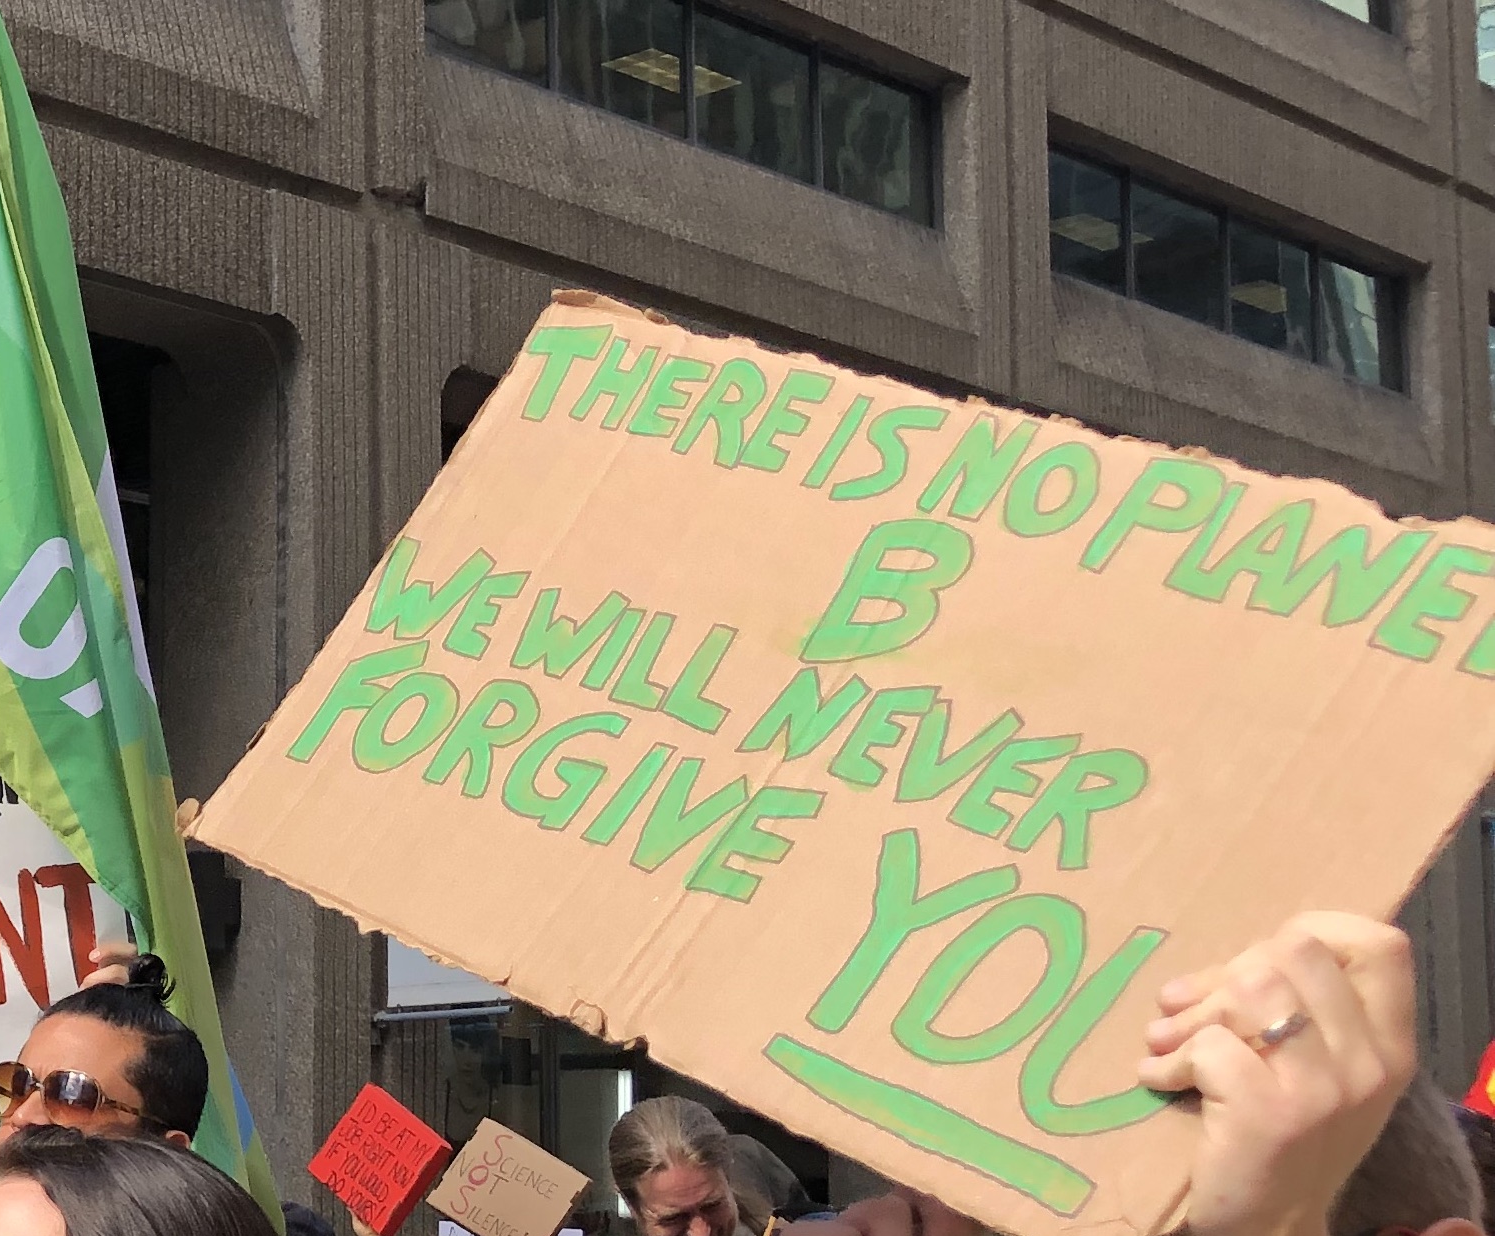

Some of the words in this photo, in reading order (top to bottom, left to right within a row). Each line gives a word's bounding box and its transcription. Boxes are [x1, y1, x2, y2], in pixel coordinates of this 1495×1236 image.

[521, 324, 836, 473] THERE
[800, 394, 951, 501] IS
[916, 410, 1101, 538] NO
[798, 518, 974, 665] B
[365, 536, 532, 661] WE
[510, 587, 739, 735] WILL
[735, 667, 1149, 871] NEVER
[286, 640, 827, 903] FORGIVE
[805, 827, 1180, 1137] YOU
[324, 1140, 347, 1159] IF
[339, 1151, 364, 1179] YOU
[358, 1166, 390, 1203] WOULD
[338, 1117, 364, 1144] JOB
[359, 1134, 395, 1170] RIGHT
[388, 1160, 416, 1189] NOW
[374, 1112, 400, 1140] BE
[391, 1126, 416, 1150] AT
[409, 1138, 434, 1167] MY
[450, 1150, 509, 1196] NOT
[482, 1134, 560, 1200] SCIENCE
[326, 1170, 346, 1194] DO
